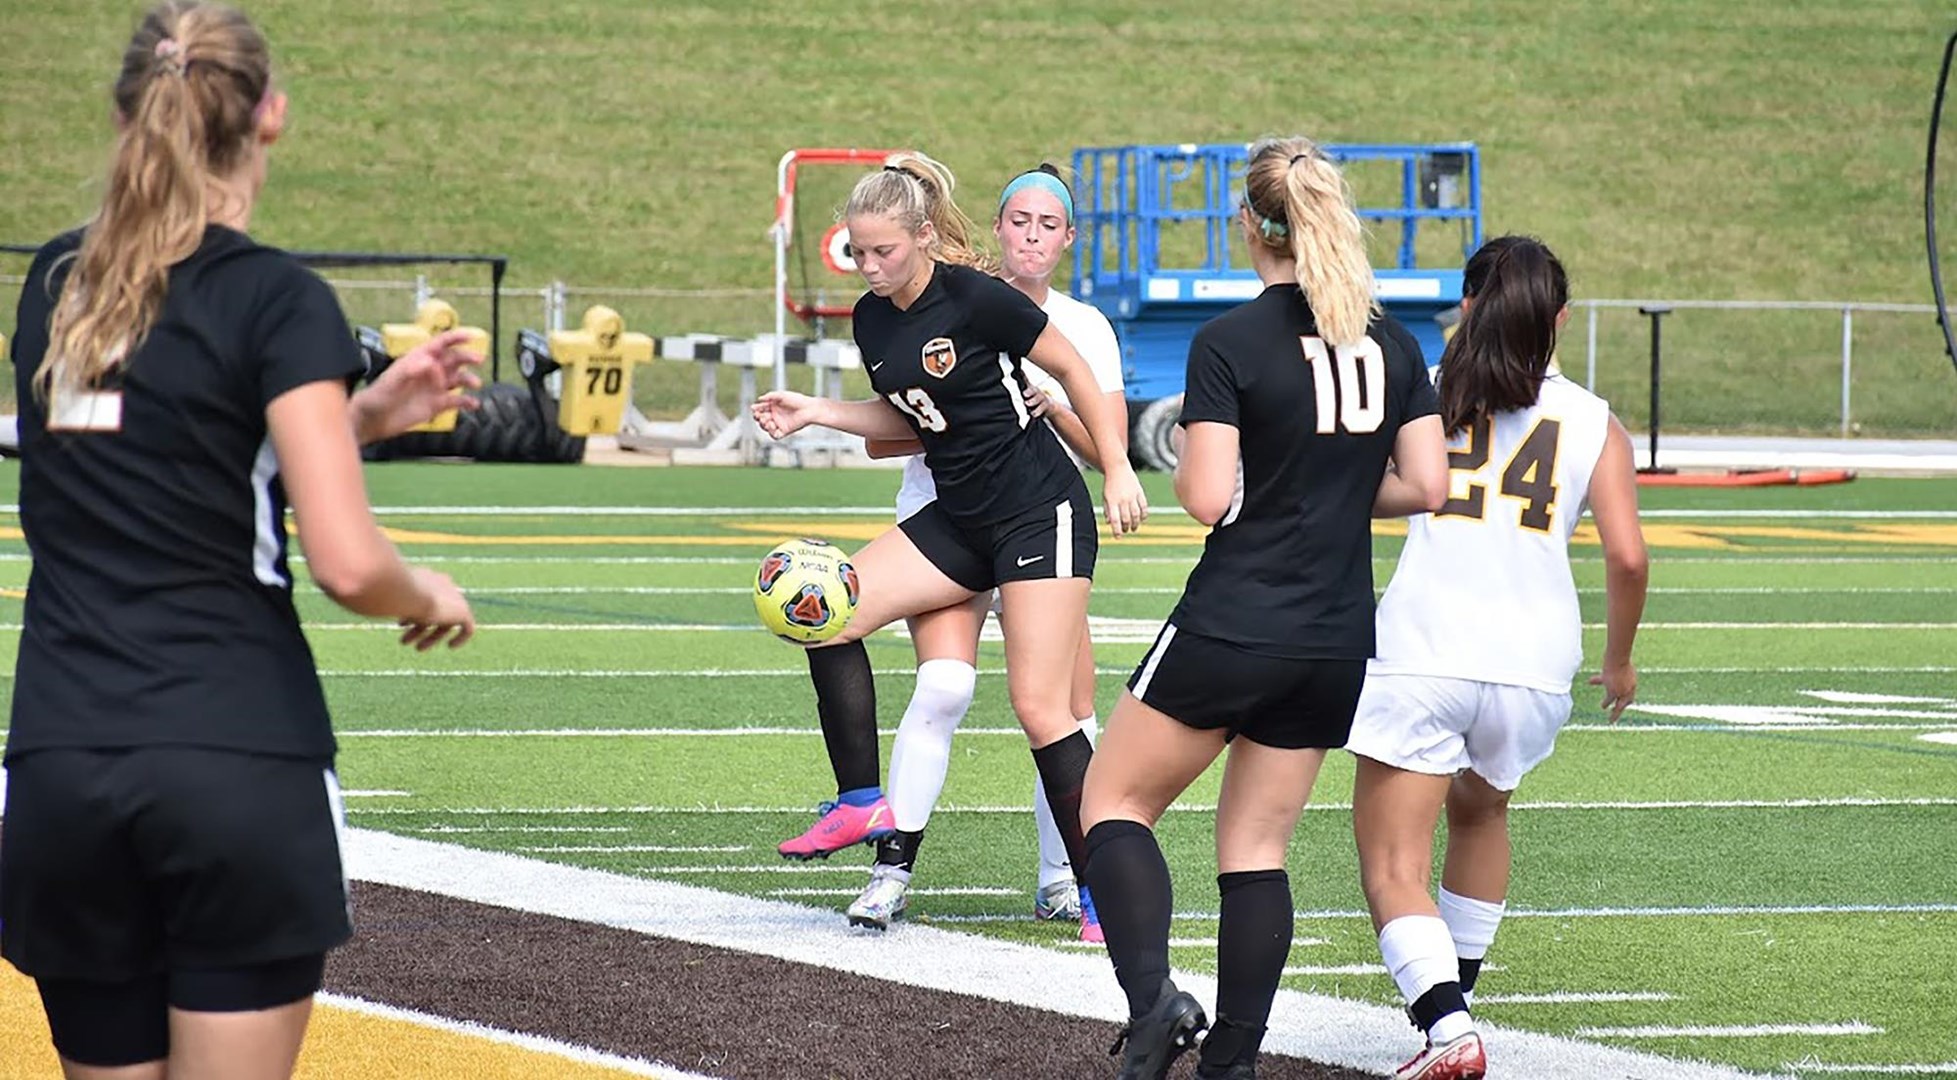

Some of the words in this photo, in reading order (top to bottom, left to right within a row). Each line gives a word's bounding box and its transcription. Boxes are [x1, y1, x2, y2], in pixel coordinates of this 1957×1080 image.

[586, 367, 622, 395] 70
[1299, 335, 1385, 434] 10
[888, 386, 948, 432] 13
[1432, 411, 1561, 533] 24
[798, 561, 829, 573] NCAA
